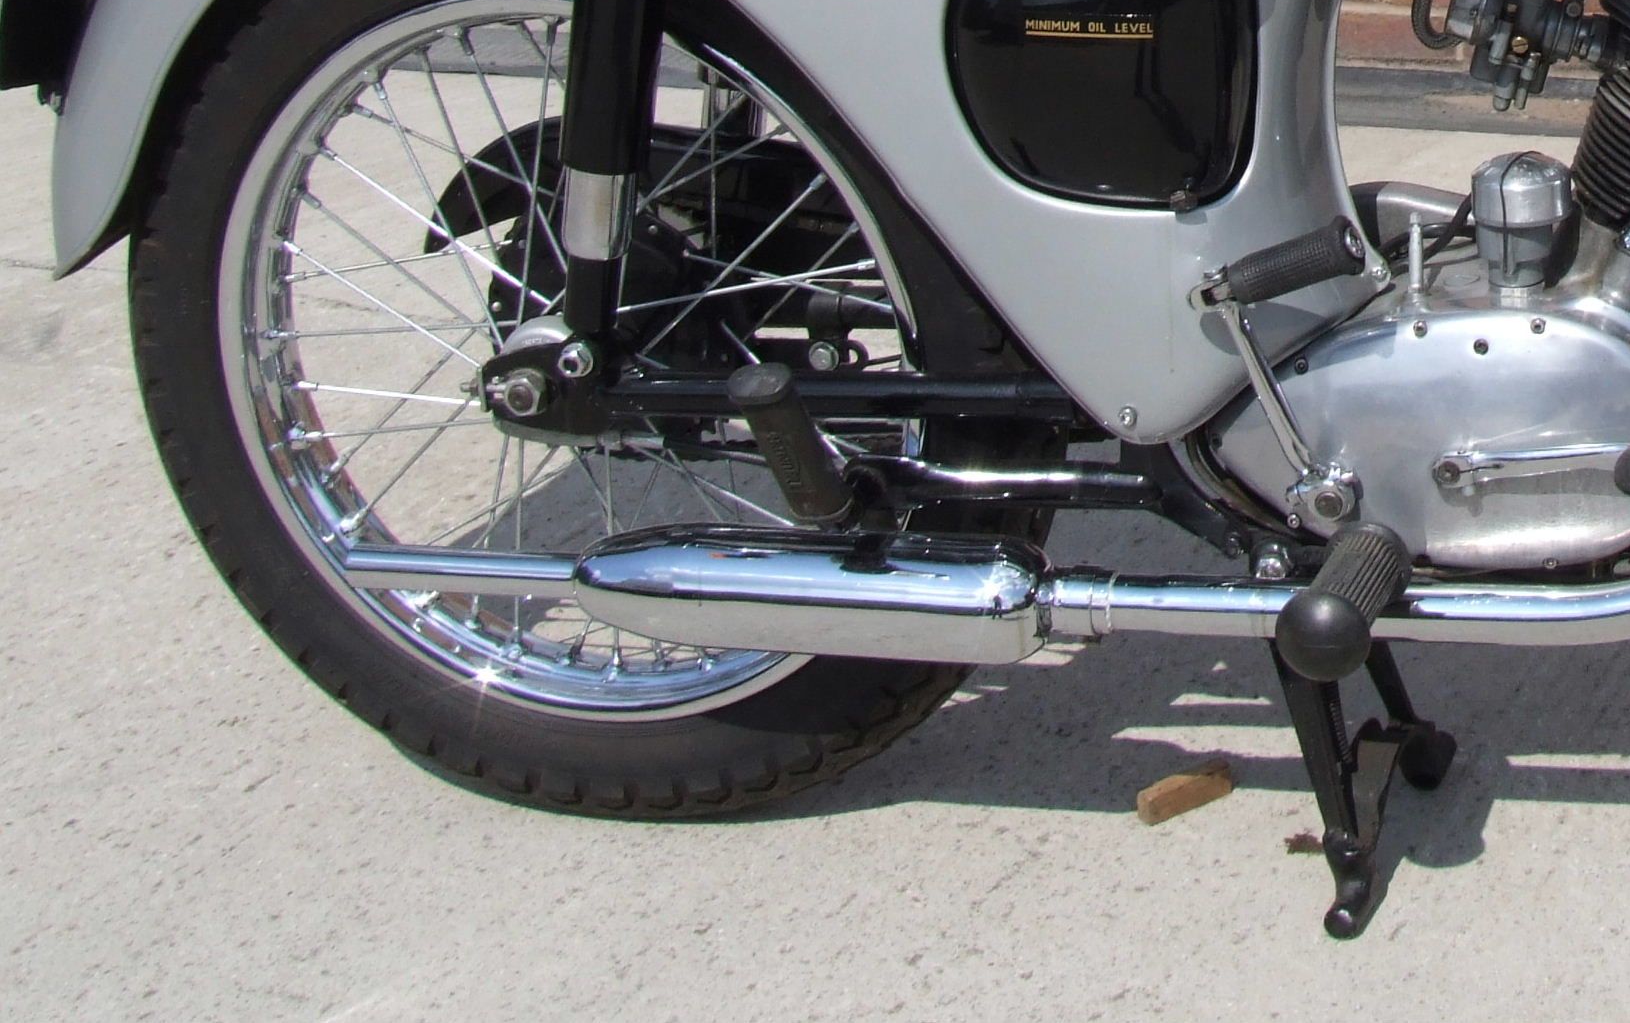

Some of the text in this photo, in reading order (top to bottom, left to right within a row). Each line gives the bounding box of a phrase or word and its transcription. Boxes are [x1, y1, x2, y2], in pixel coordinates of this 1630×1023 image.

[1025, 19, 1153, 34] MINIMUM OIL LEVEL
